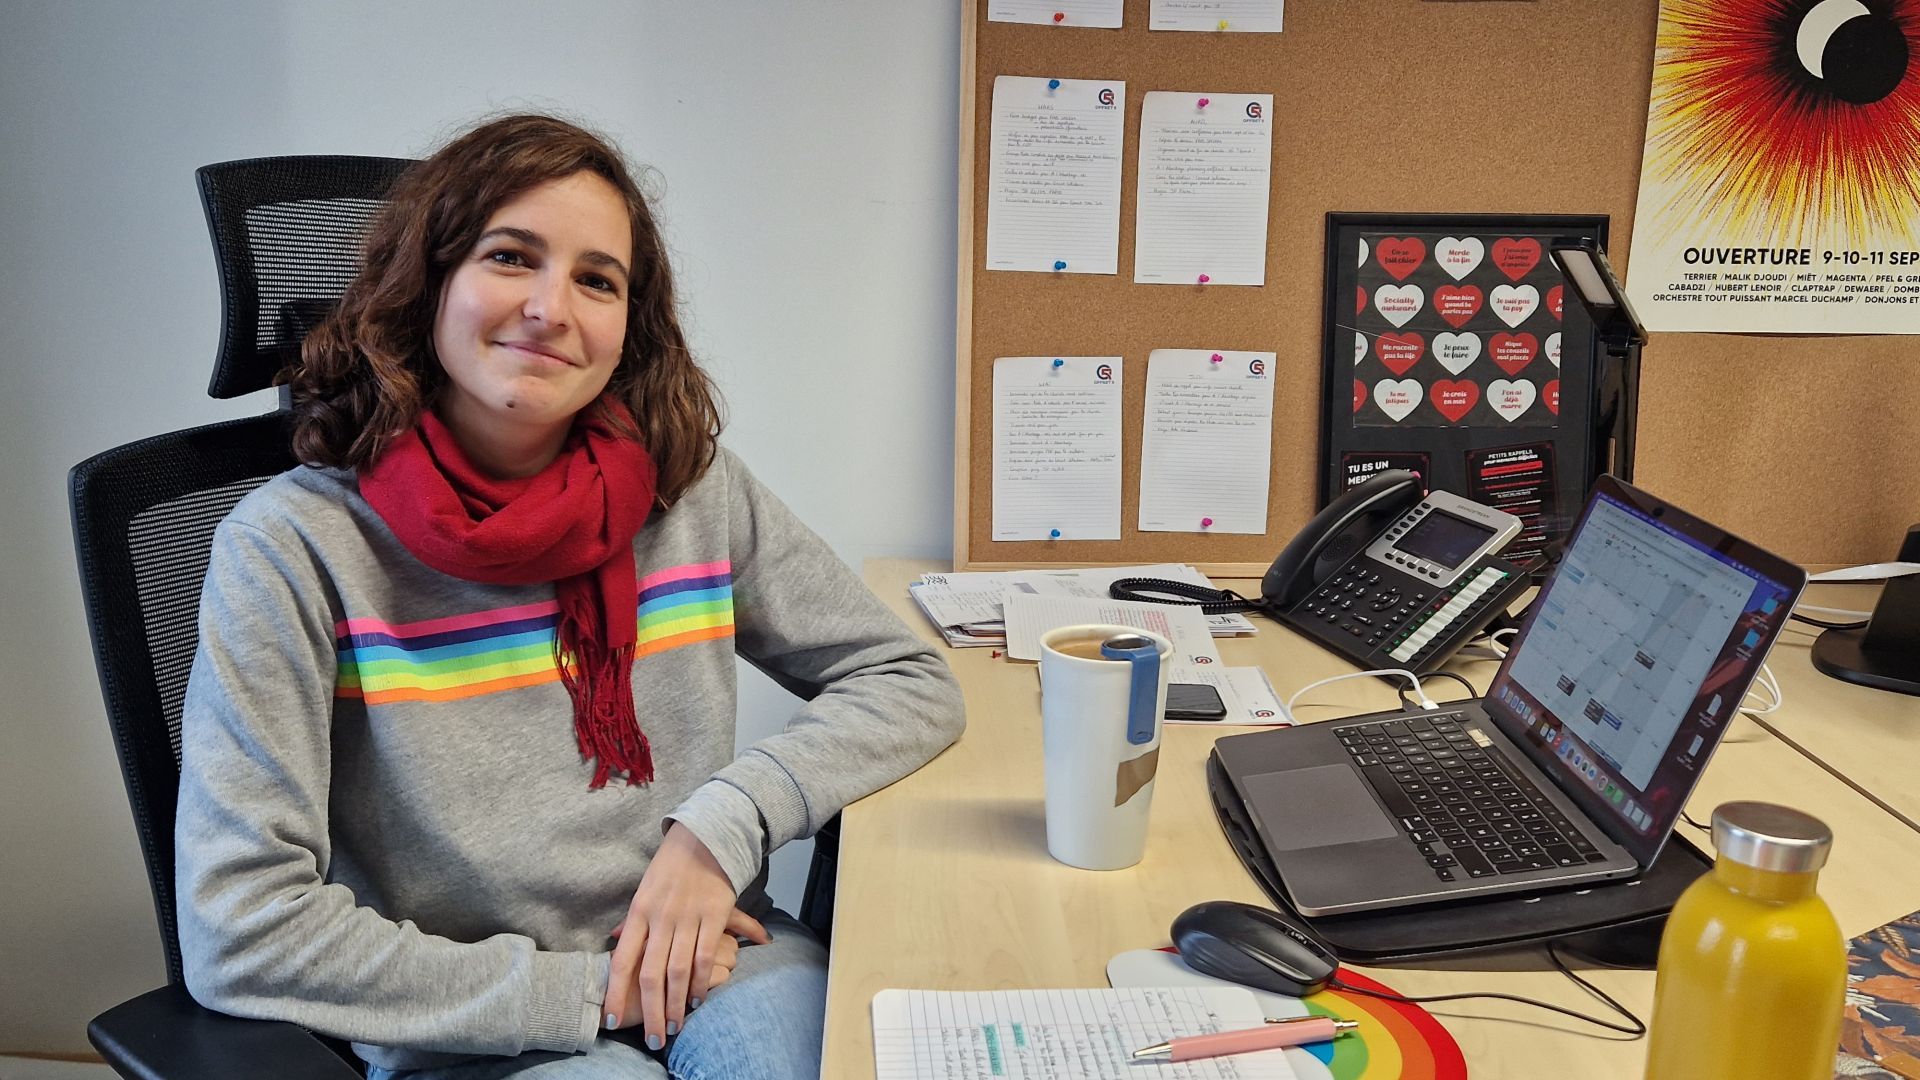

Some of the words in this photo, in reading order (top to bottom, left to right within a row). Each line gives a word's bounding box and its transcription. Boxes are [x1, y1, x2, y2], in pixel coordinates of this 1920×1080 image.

[1684, 247, 1811, 265] OUVERTURE
[1823, 250, 1884, 264] 9-10-11
[1889, 251, 1920, 265] SEP
[1753, 273, 1786, 281] DJOUDI
[1826, 274, 1866, 282] MAGENTA
[1750, 284, 1782, 292] LENOIR
[1791, 284, 1835, 292] CLAPTRAP
[1652, 293, 1702, 301] ORCHESTRE
[1704, 294, 1727, 302] TOUT
[1811, 295, 1854, 303] DUCHAMP
[1865, 296, 1907, 304] DONJONS
[1348, 464, 1360, 474] TU
[1361, 462, 1373, 471] ES
[1375, 460, 1389, 470] UN
